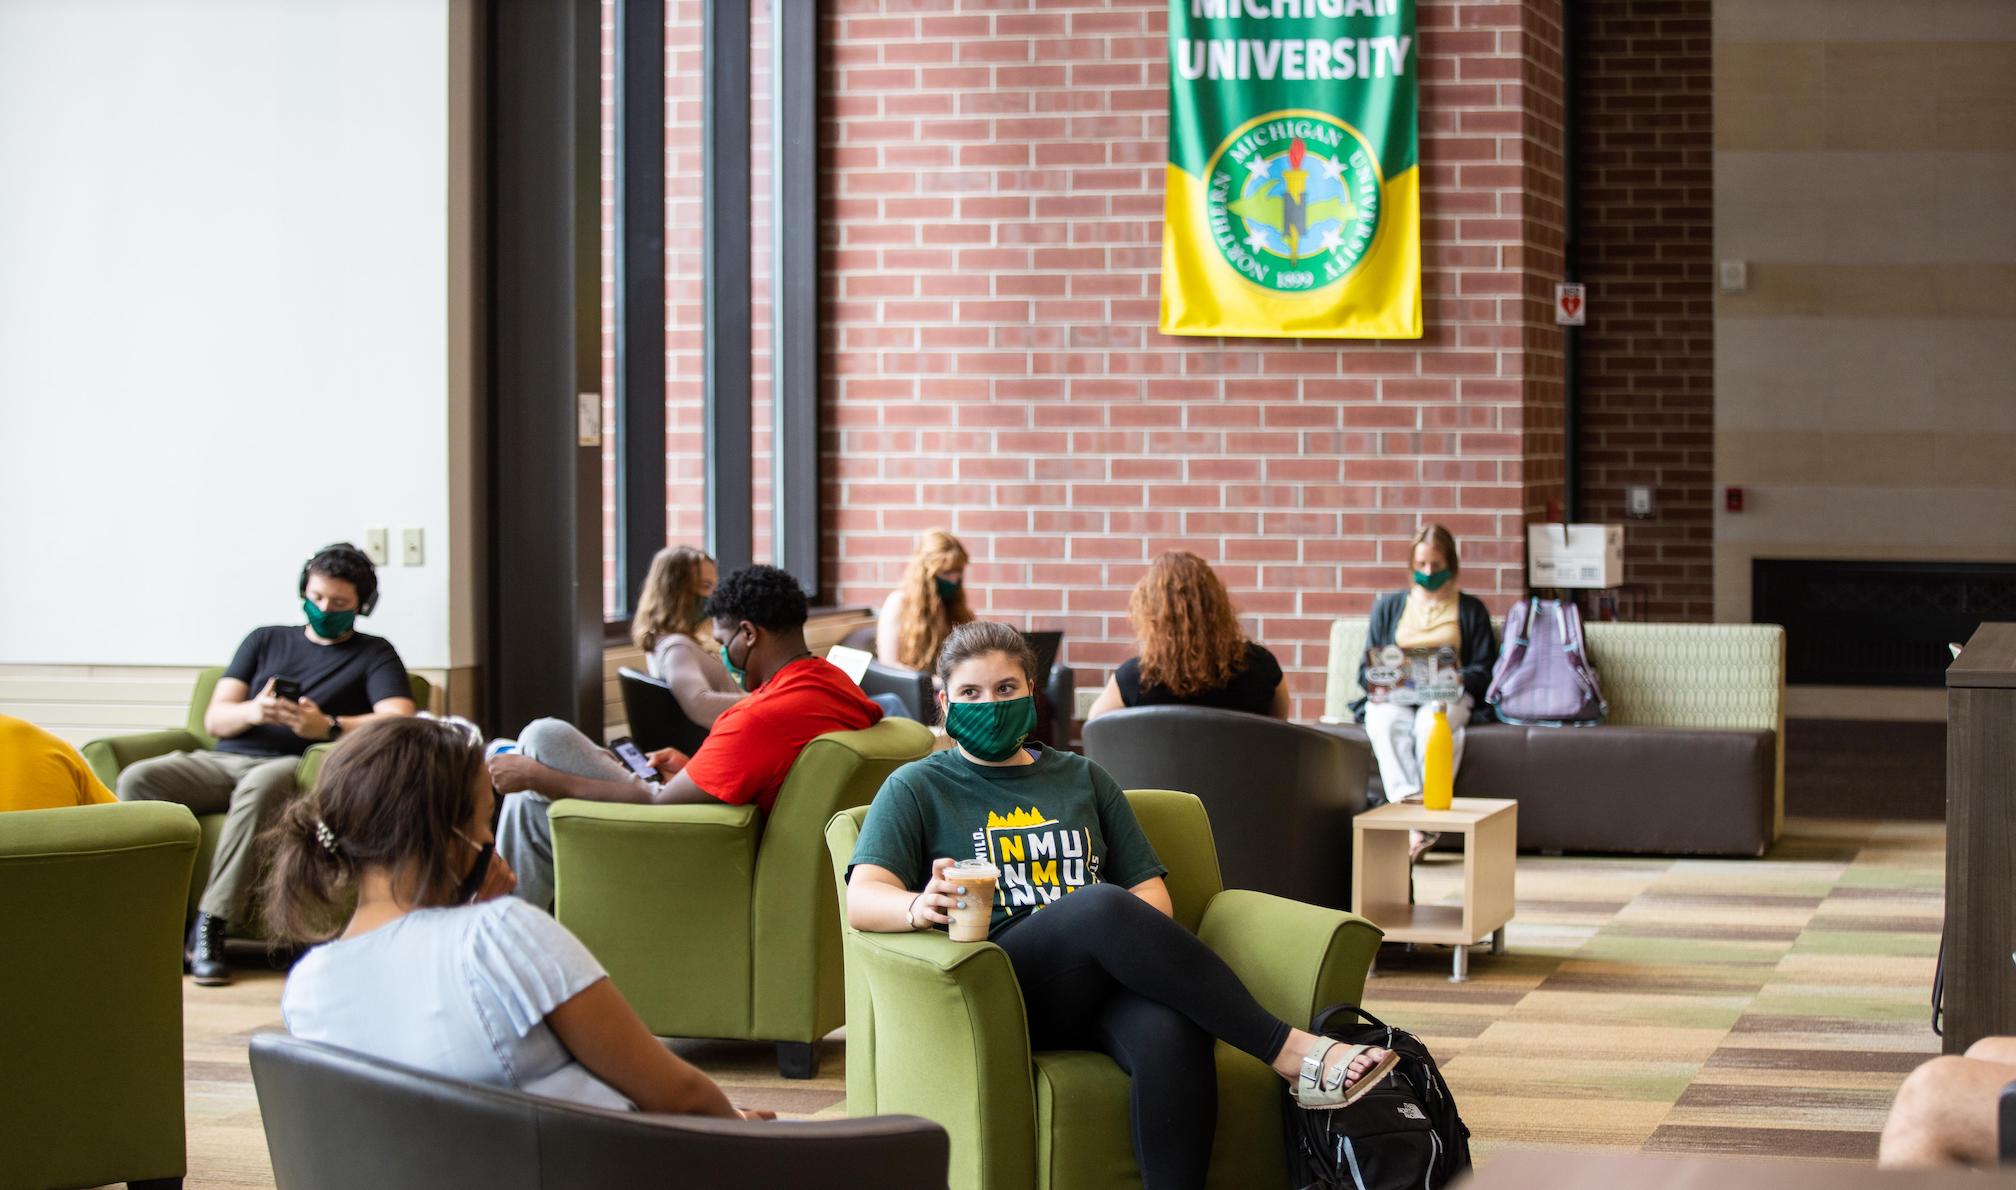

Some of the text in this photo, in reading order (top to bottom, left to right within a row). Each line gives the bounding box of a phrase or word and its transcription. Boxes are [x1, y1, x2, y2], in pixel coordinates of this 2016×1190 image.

[1178, 36, 1412, 80] UNIVERSITY
[1209, 120, 1377, 282] NORTHERN MICHIGAN UNIVERSITY
[1276, 271, 1314, 288] 1899
[1000, 830, 1083, 863] NMU
[1004, 858, 1086, 888] NMU
[1010, 885, 1083, 907] NM
